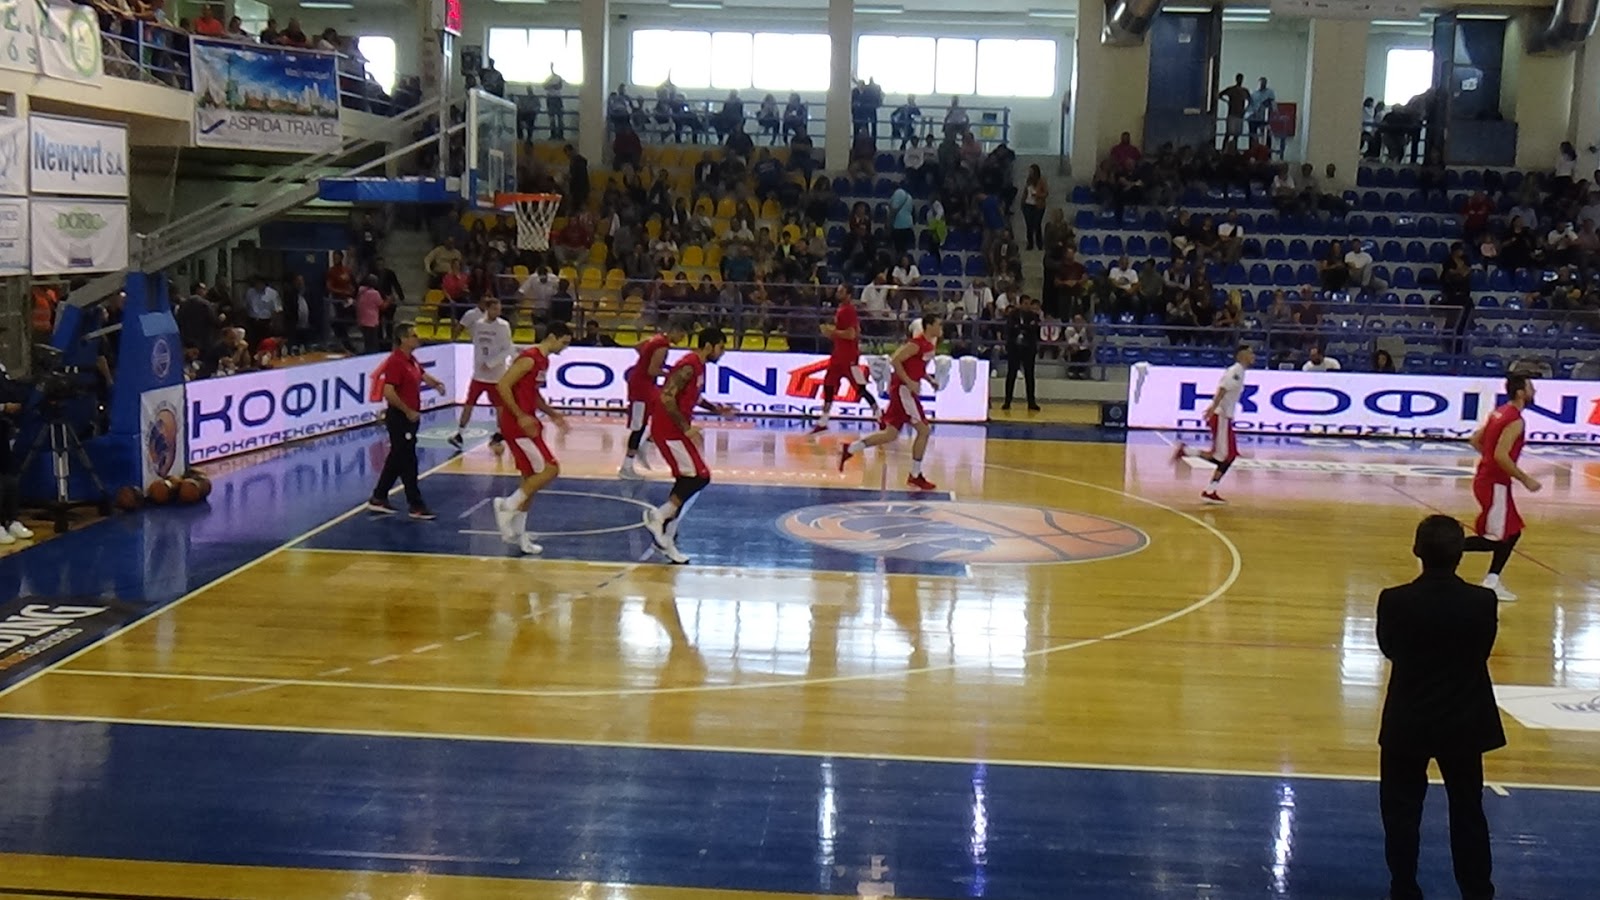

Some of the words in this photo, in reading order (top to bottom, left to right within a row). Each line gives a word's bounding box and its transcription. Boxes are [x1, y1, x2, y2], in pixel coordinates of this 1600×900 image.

[228, 116, 281, 132] ASPIDA
[286, 119, 339, 137] TRAVEL
[34, 131, 102, 180] Newport
